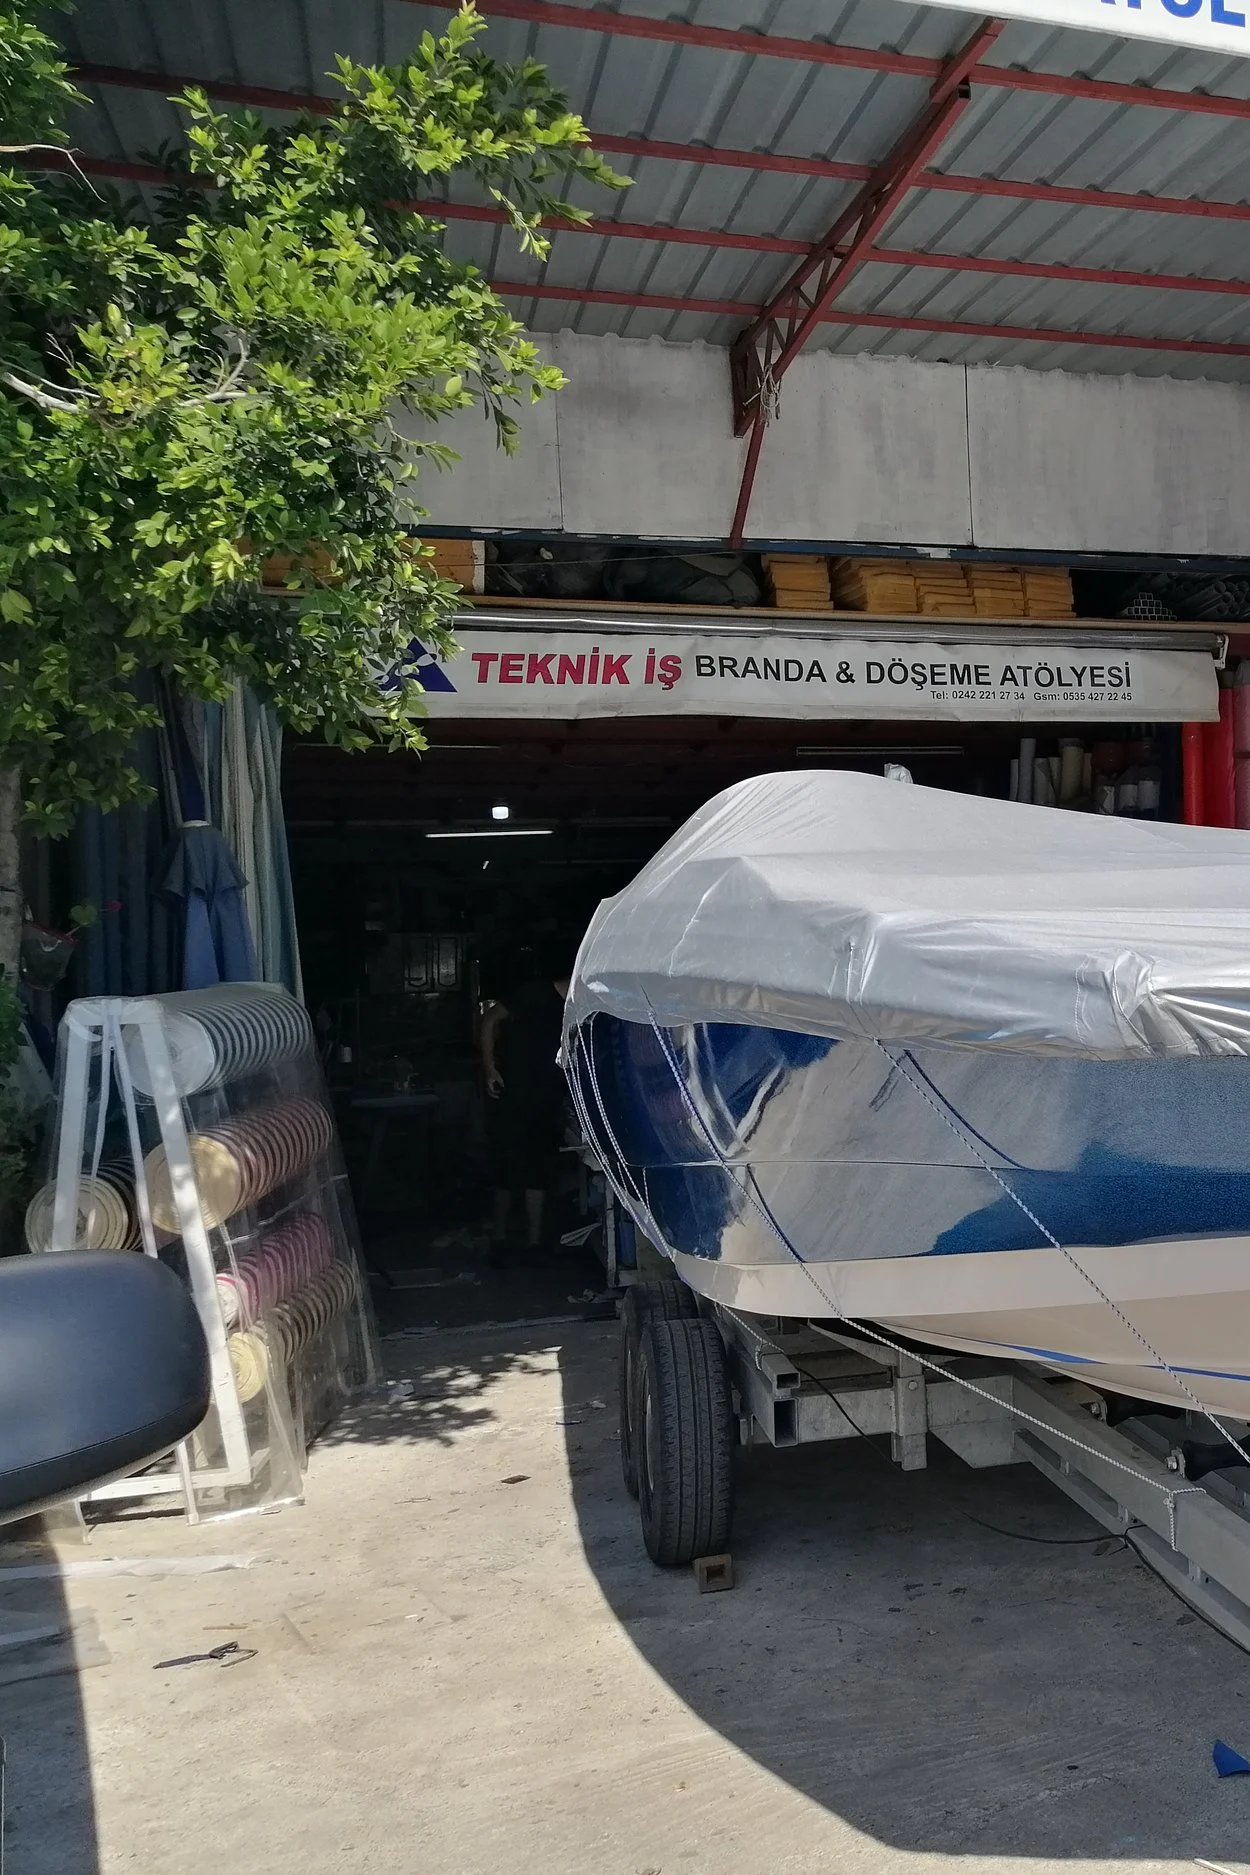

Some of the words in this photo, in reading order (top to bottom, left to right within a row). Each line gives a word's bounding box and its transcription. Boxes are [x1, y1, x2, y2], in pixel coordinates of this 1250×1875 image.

[471, 647, 632, 684] TEKNİK
[644, 648, 682, 690] İŞ
[695, 655, 827, 683] BRANDA
[835, 661, 856, 684] &
[866, 658, 992, 690] DÖŞEME
[1000, 661, 1131, 688] ATÖLYESİ
[930, 690, 949, 700] Tel:
[951, 690, 976, 700] 0242
[979, 691, 996, 700] 221
[999, 691, 1011, 700] 27
[1014, 692, 1025, 700] 34
[1033, 692, 1060, 701] Gsm:
[1062, 692, 1086, 701] 0535
[1088, 692, 1104, 701] 427
[1107, 692, 1119, 701] 22
[1121, 692, 1133, 701] 45
